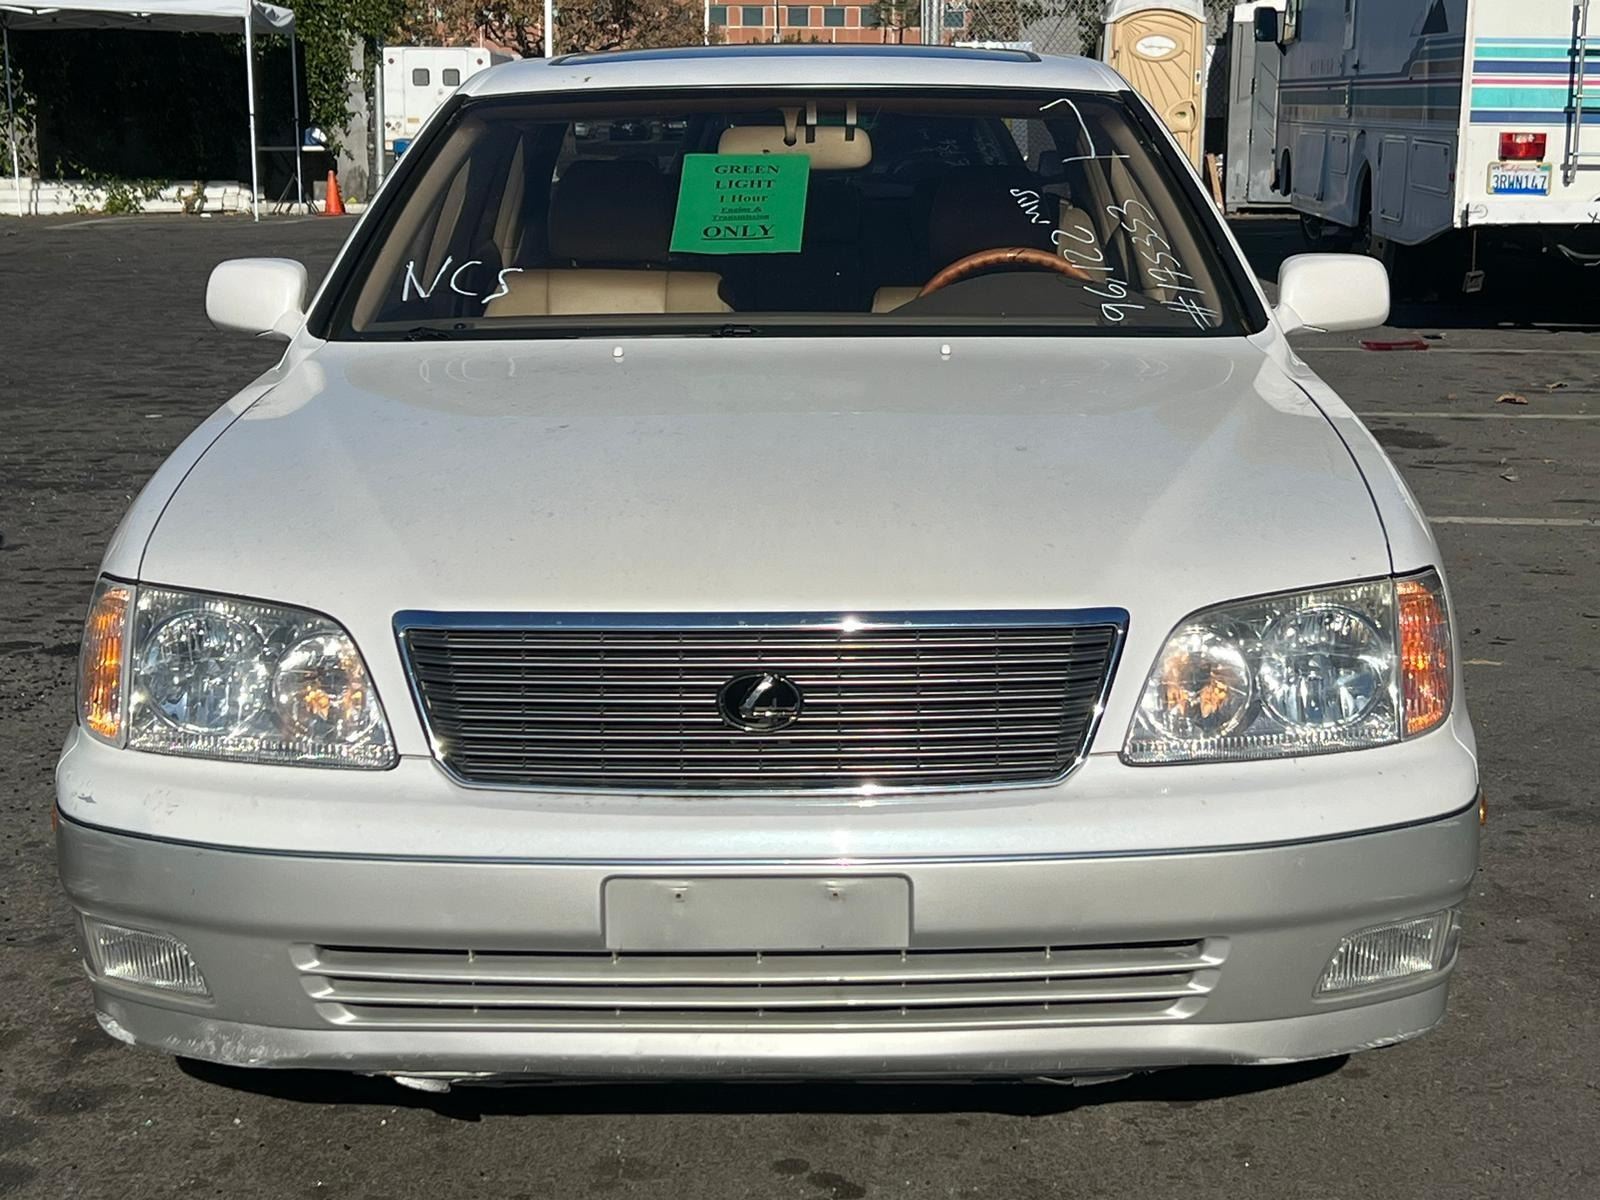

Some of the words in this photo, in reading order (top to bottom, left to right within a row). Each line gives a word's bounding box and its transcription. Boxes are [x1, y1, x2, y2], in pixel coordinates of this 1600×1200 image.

[714, 164, 780, 174] GREEN
[715, 179, 776, 189] LIGHT
[1493, 174, 1547, 189] 3RWN147
[731, 194, 769, 203] Hour
[720, 206, 751, 214] Engine
[703, 224, 775, 238] ONLY
[402, 255, 524, 304] NCS
